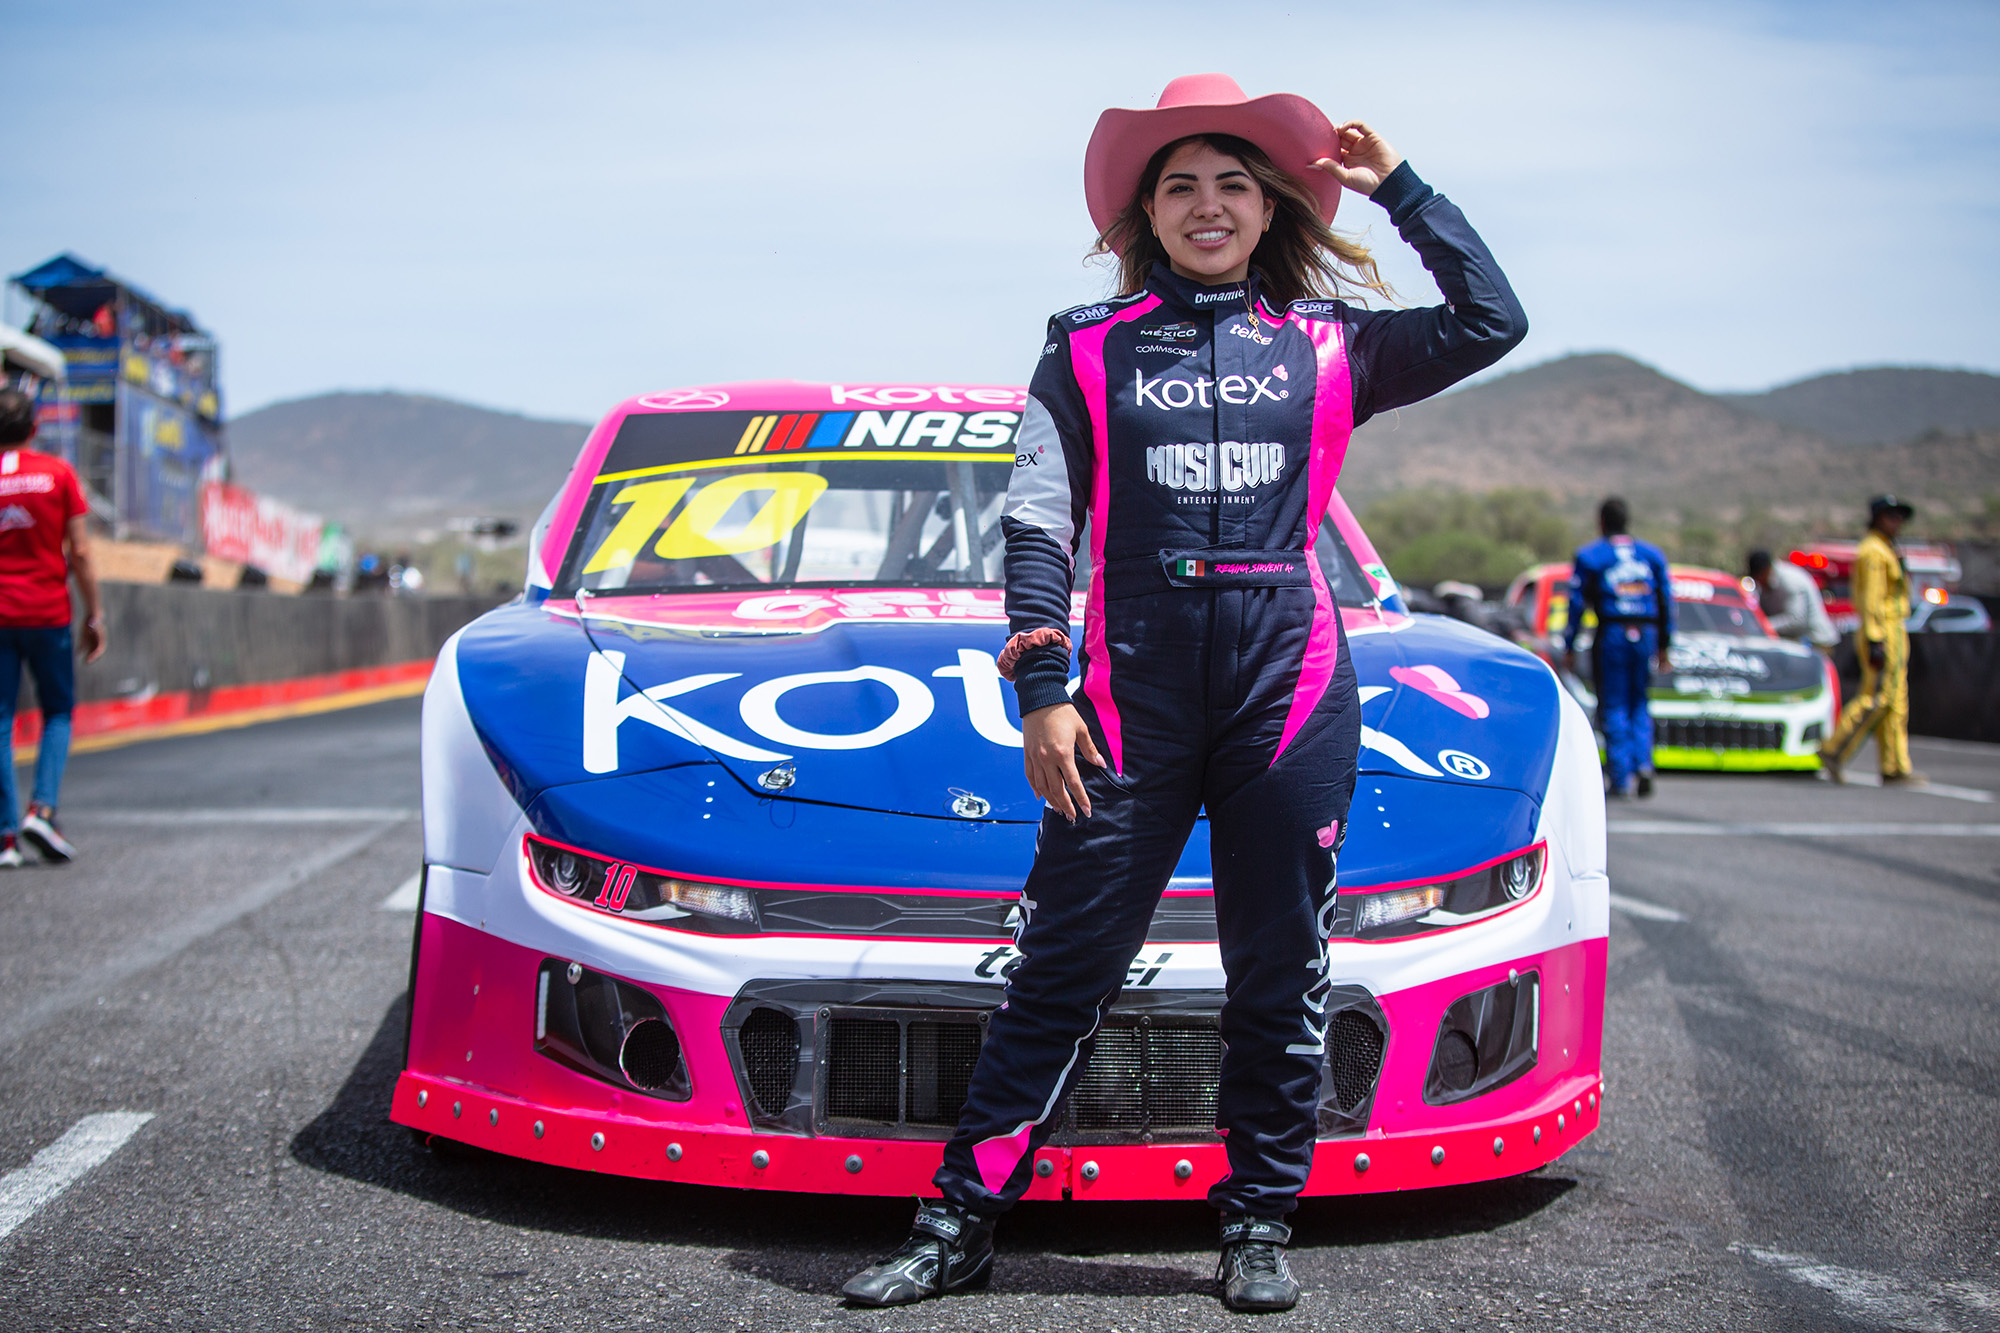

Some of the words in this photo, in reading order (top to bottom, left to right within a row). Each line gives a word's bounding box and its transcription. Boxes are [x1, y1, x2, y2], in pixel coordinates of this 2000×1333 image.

[1071, 305, 1111, 323] OMP
[1292, 303, 1334, 313] OMP
[1135, 344, 1198, 357] COMMSCOPE
[1136, 368, 1282, 411] kotex
[843, 410, 1024, 449] NAS
[1177, 495, 1256, 505] ENTERTAINMENT
[582, 471, 829, 575] 10
[1214, 563, 1249, 575] REGINA
[1249, 562, 1284, 574] SIRVENT
[594, 862, 638, 912] 10
